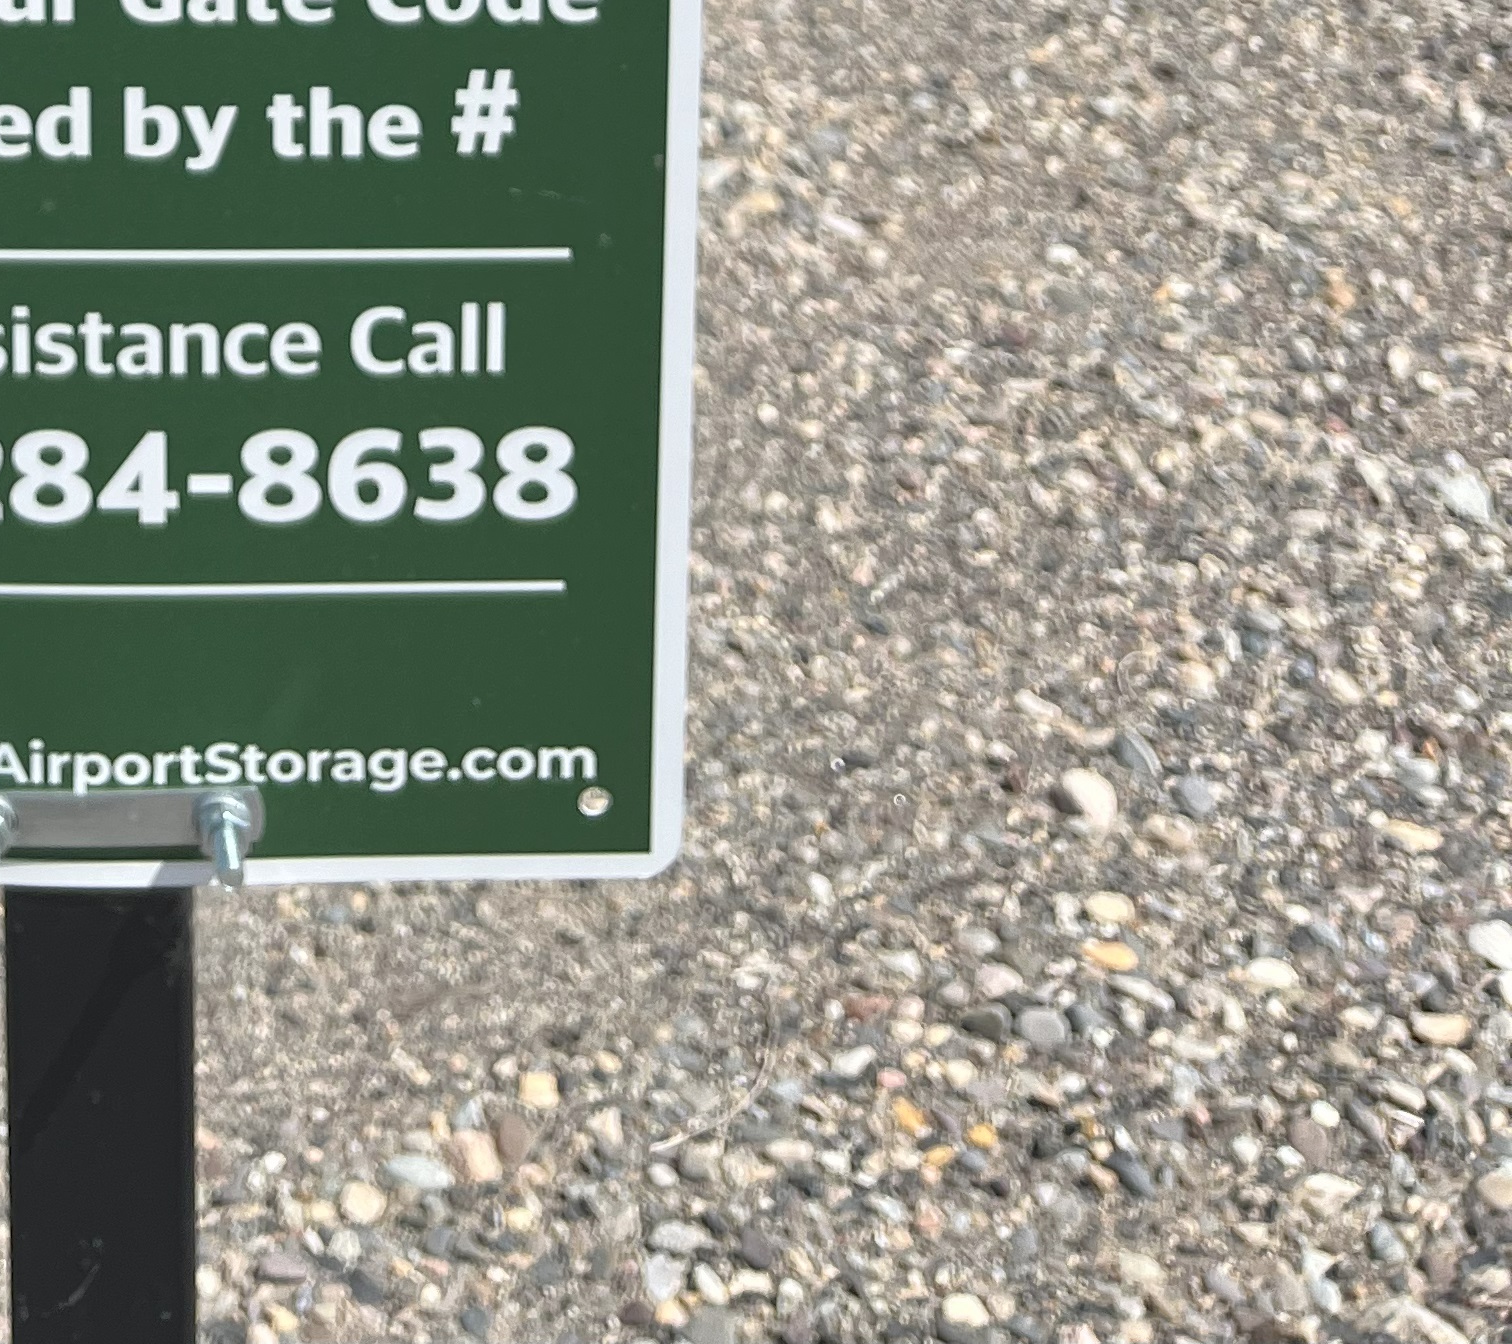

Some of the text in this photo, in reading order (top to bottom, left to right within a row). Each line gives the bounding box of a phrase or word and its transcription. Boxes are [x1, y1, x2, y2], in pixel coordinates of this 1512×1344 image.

[123, 85, 239, 172] by
[265, 85, 422, 159] the
[450, 67, 519, 156] #
[349, 300, 506, 376] Call
